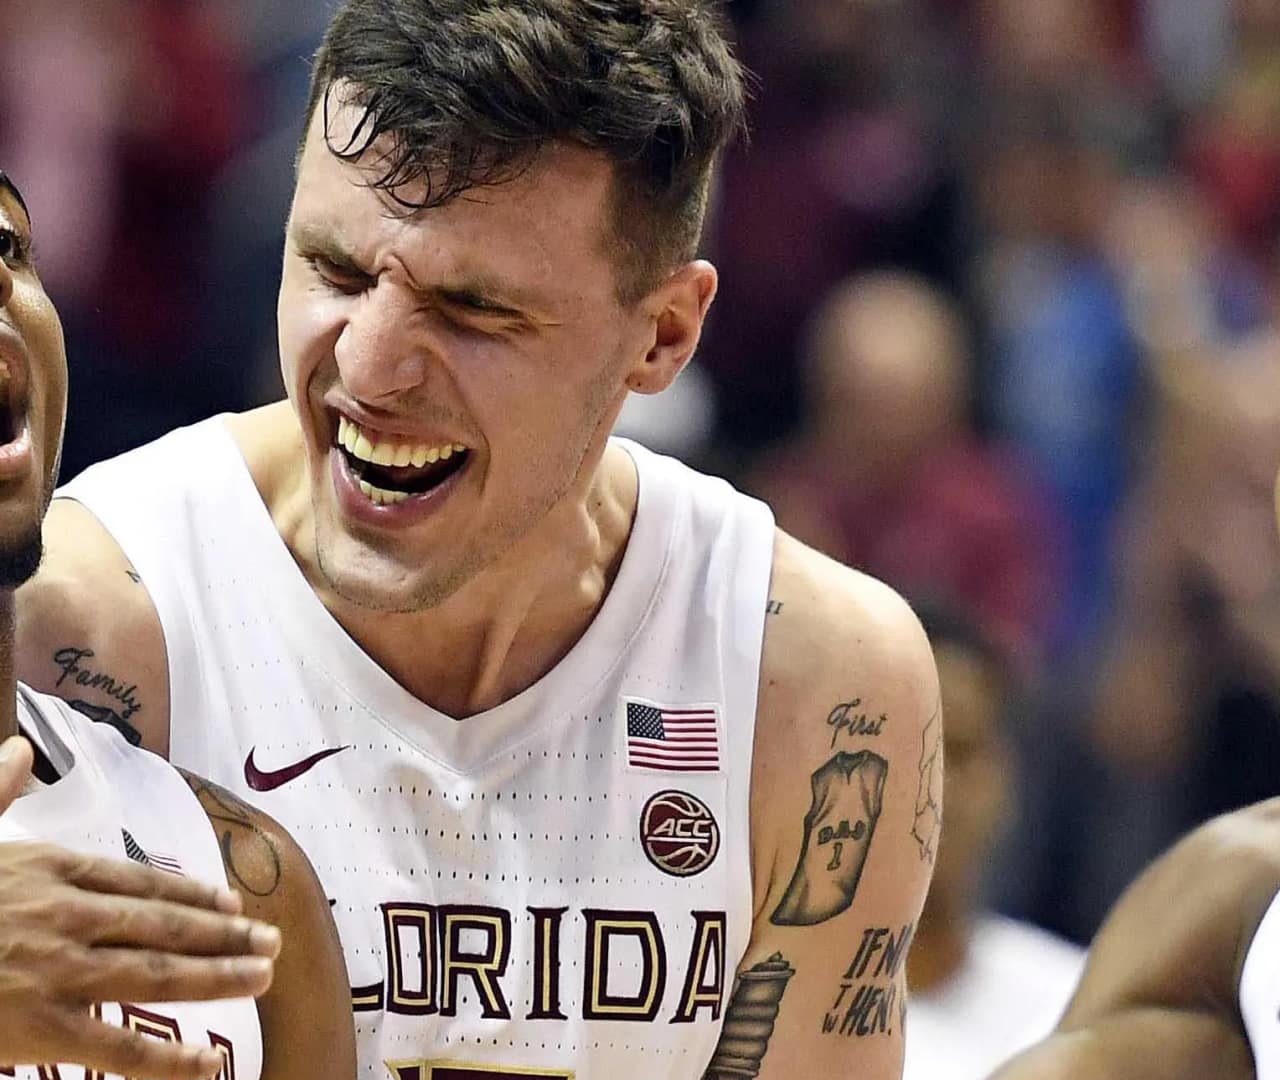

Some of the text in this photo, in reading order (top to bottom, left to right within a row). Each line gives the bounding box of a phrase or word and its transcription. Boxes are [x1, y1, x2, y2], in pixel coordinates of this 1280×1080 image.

[54, 647, 142, 719] Family
[827, 698, 888, 749] First
[652, 818, 714, 837] ACC
